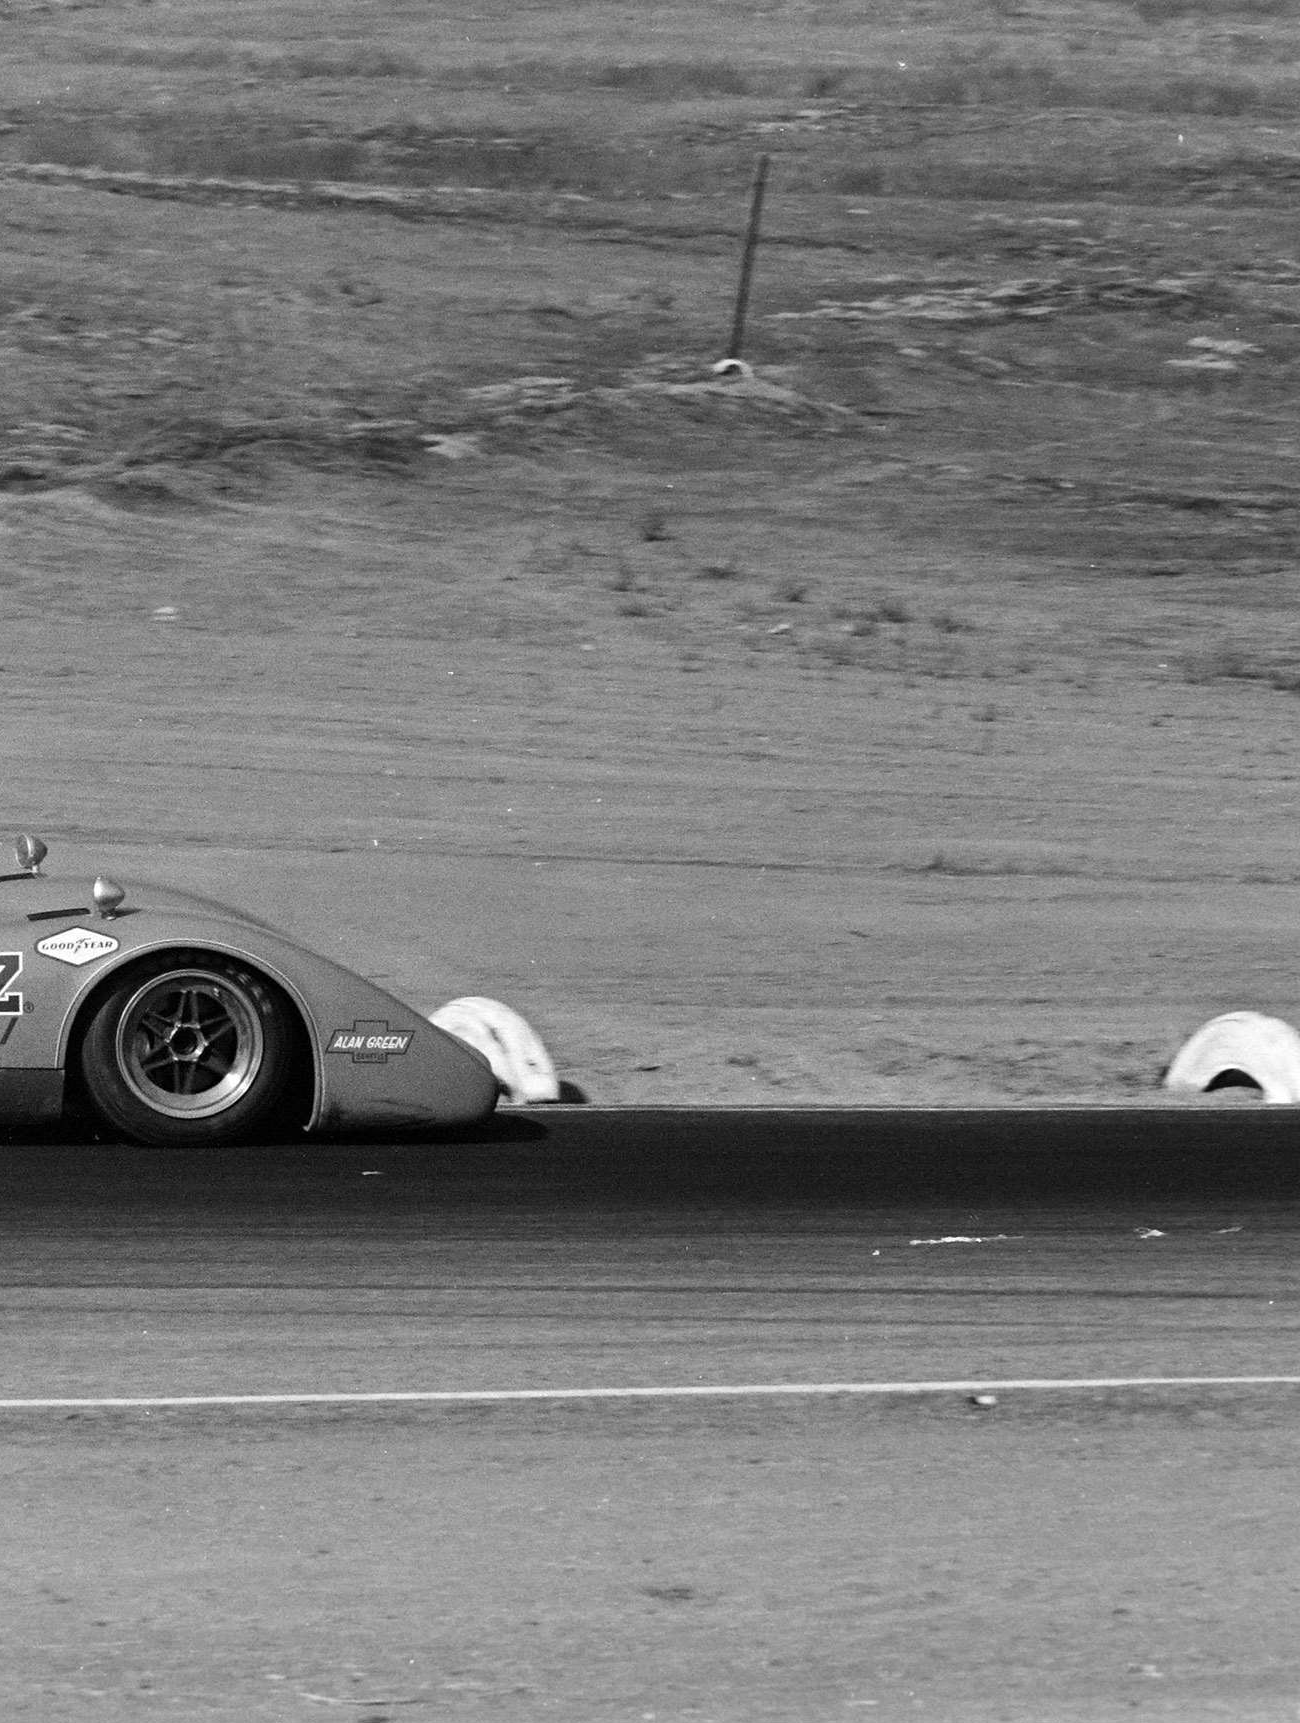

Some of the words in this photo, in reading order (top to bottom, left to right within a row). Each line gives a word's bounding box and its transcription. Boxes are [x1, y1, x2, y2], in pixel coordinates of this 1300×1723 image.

[41, 939, 114, 951] GOODYEAR
[333, 1036, 365, 1048] ALAN
[366, 1036, 408, 1049] GREEN
